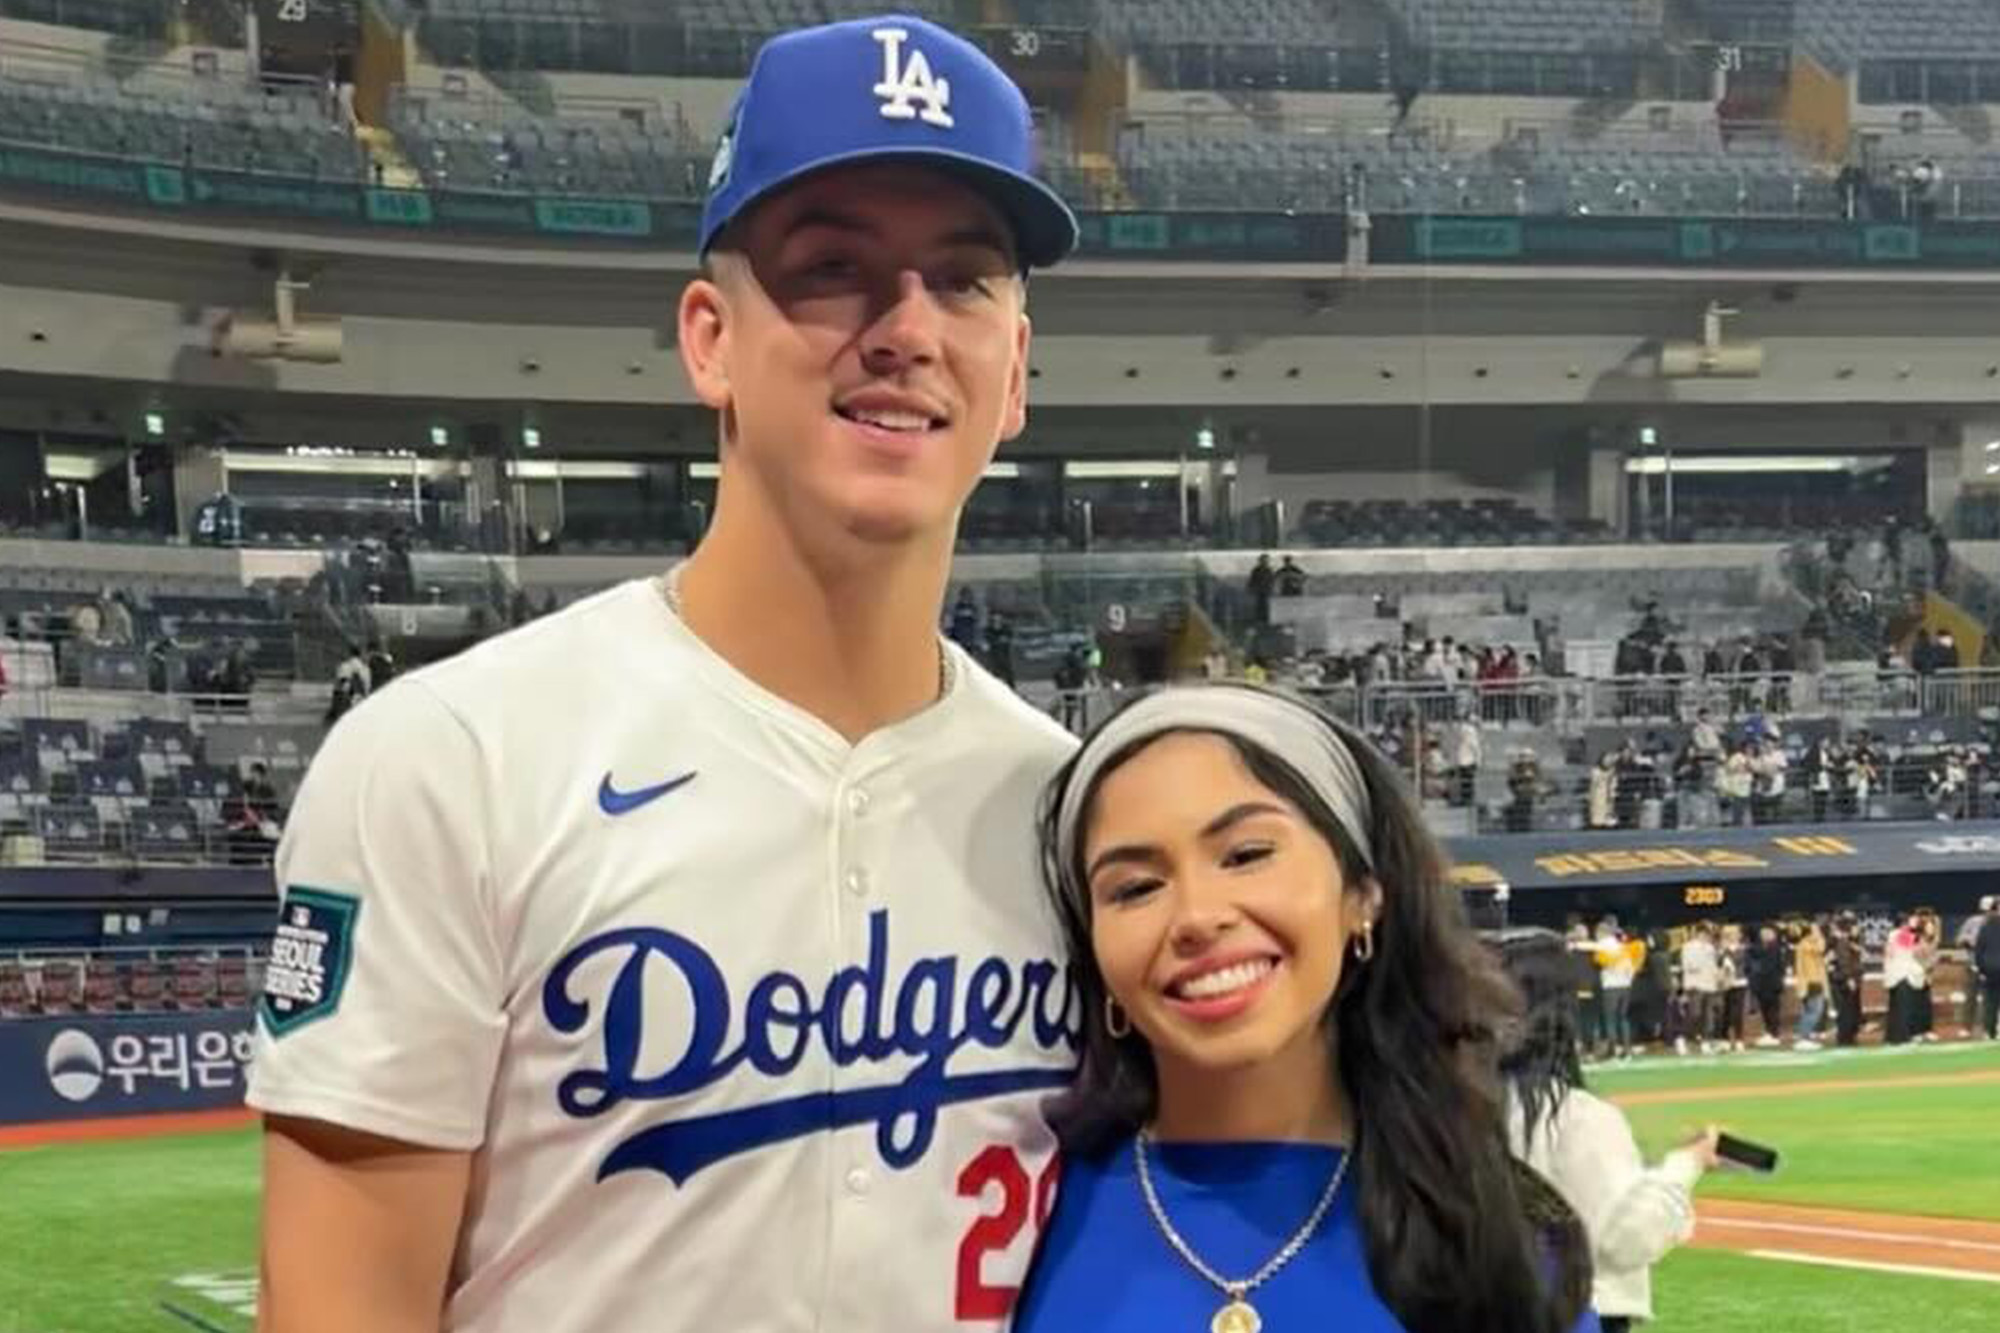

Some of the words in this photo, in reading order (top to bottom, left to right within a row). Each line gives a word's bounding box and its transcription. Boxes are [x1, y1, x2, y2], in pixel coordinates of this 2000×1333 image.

[1011, 32, 1039, 56] 30
[1716, 46, 1742, 71] 31
[873, 29, 954, 128] LA
[1108, 603, 1125, 632] 9
[271, 937, 326, 974] SEOUL
